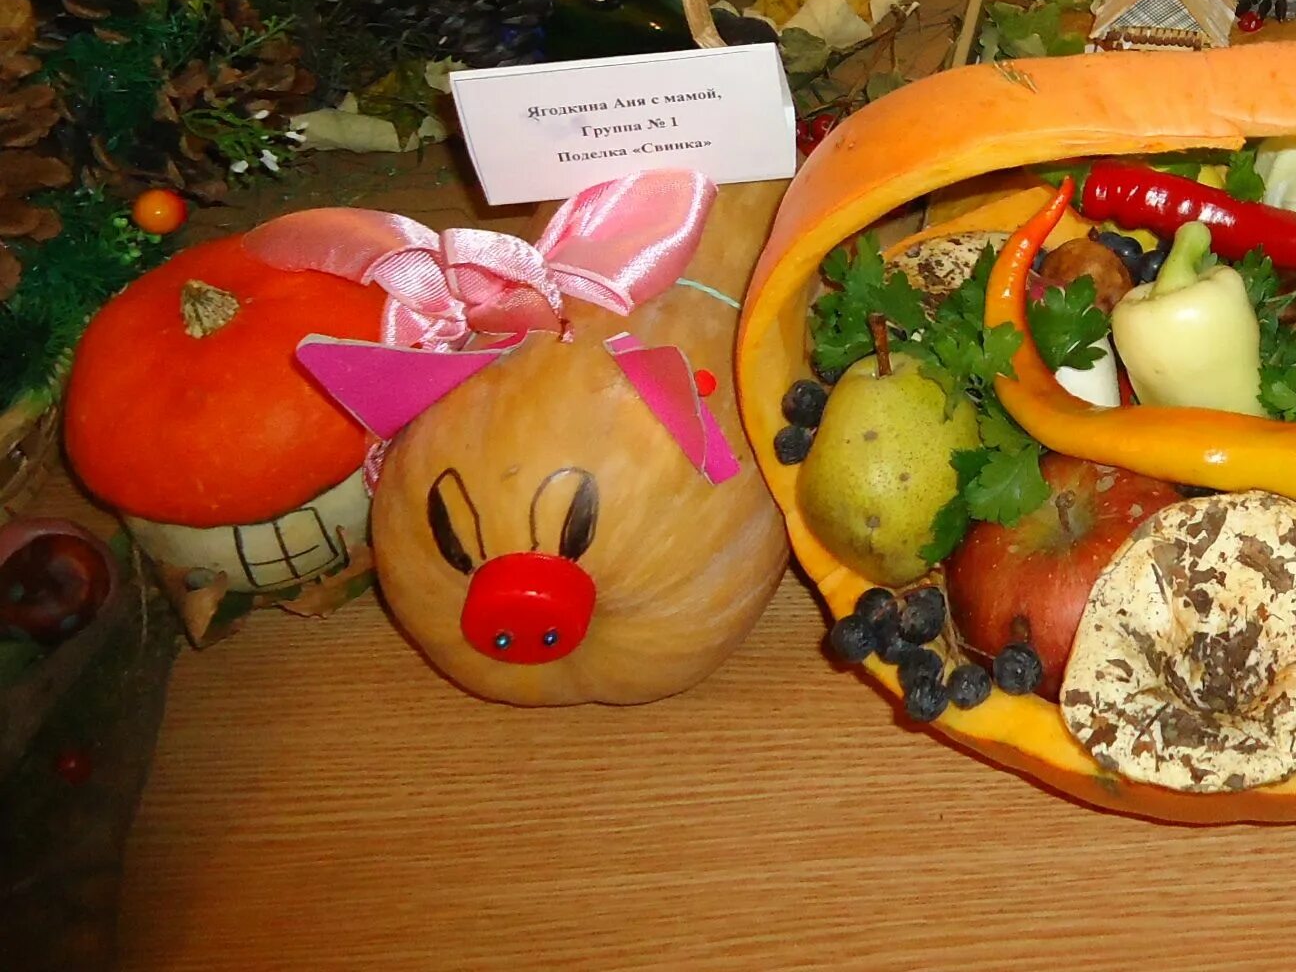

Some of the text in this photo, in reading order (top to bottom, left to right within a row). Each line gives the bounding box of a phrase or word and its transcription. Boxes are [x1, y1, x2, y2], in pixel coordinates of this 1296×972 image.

[527, 88, 723, 119] Ягодкина Аня с мамой,
[580, 116, 679, 139] Группа № 1
[557, 138, 712, 163] Поделка «Свинка»
